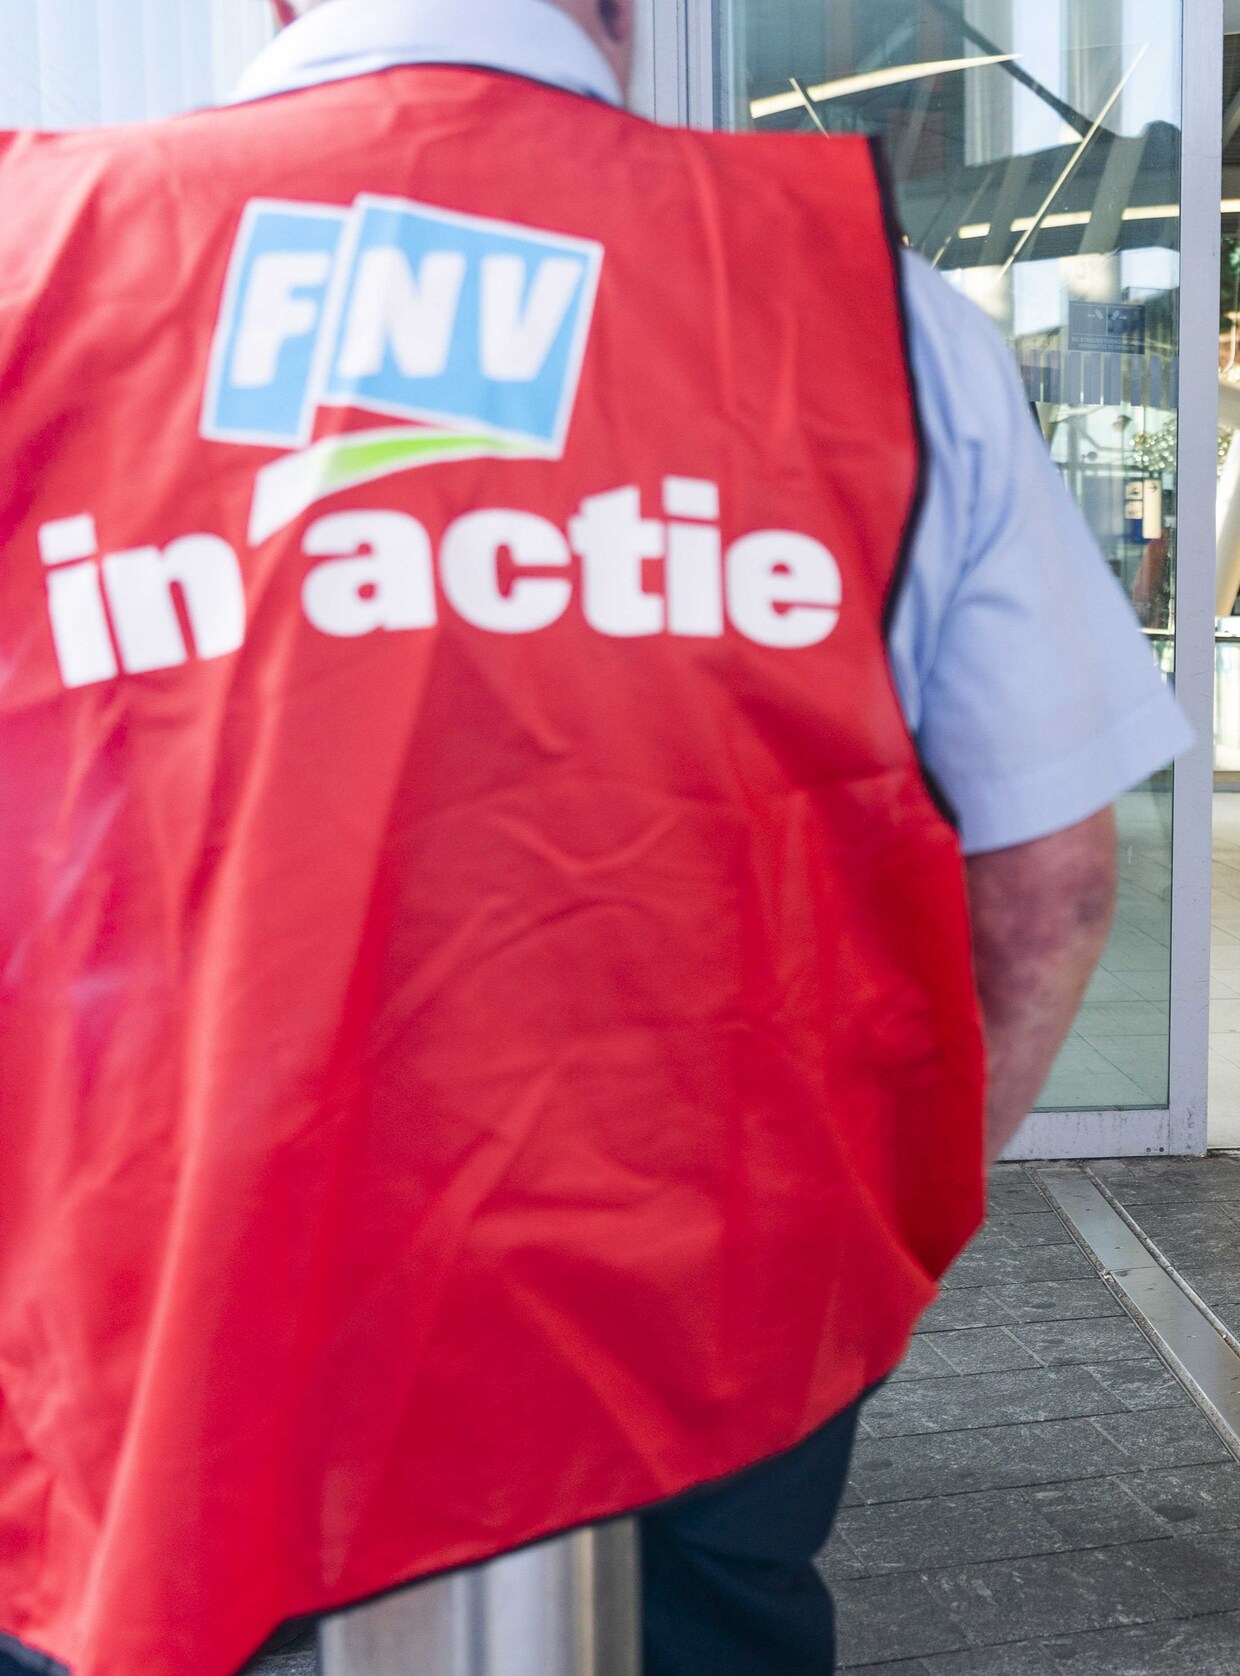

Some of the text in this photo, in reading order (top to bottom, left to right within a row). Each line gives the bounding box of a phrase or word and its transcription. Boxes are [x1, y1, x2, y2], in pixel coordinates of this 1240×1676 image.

[229, 244, 585, 390] FNV
[37, 474, 843, 690] in actie
